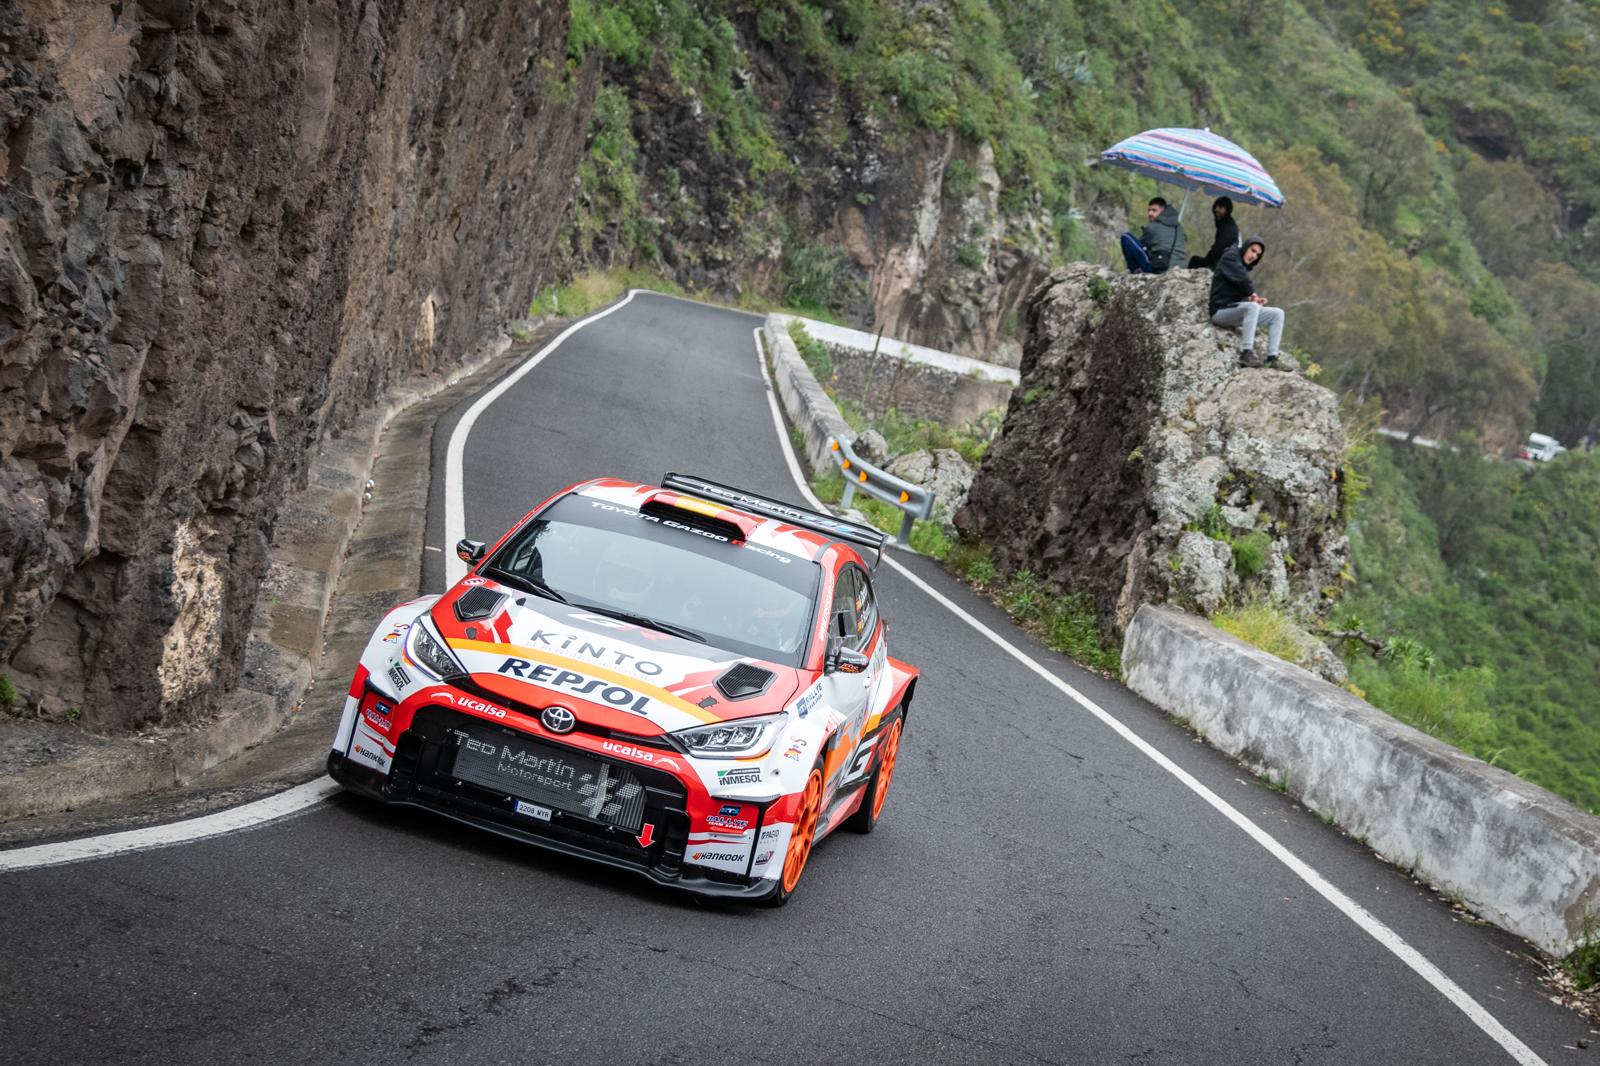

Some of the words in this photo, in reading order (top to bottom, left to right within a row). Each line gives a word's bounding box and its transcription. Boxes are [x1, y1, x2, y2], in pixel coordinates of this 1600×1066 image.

[591, 501, 660, 523] TOYOTA
[662, 519, 729, 542] GAZOO
[497, 658, 651, 716] REPSOL
[457, 696, 507, 719] ucalsa
[454, 729, 497, 756] Teo
[602, 741, 654, 762] ucalsa
[497, 761, 573, 791] Motorsport
[519, 804, 535, 814] 2208
[537, 809, 550, 818] MYR
[706, 815, 748, 827] RALLYE
